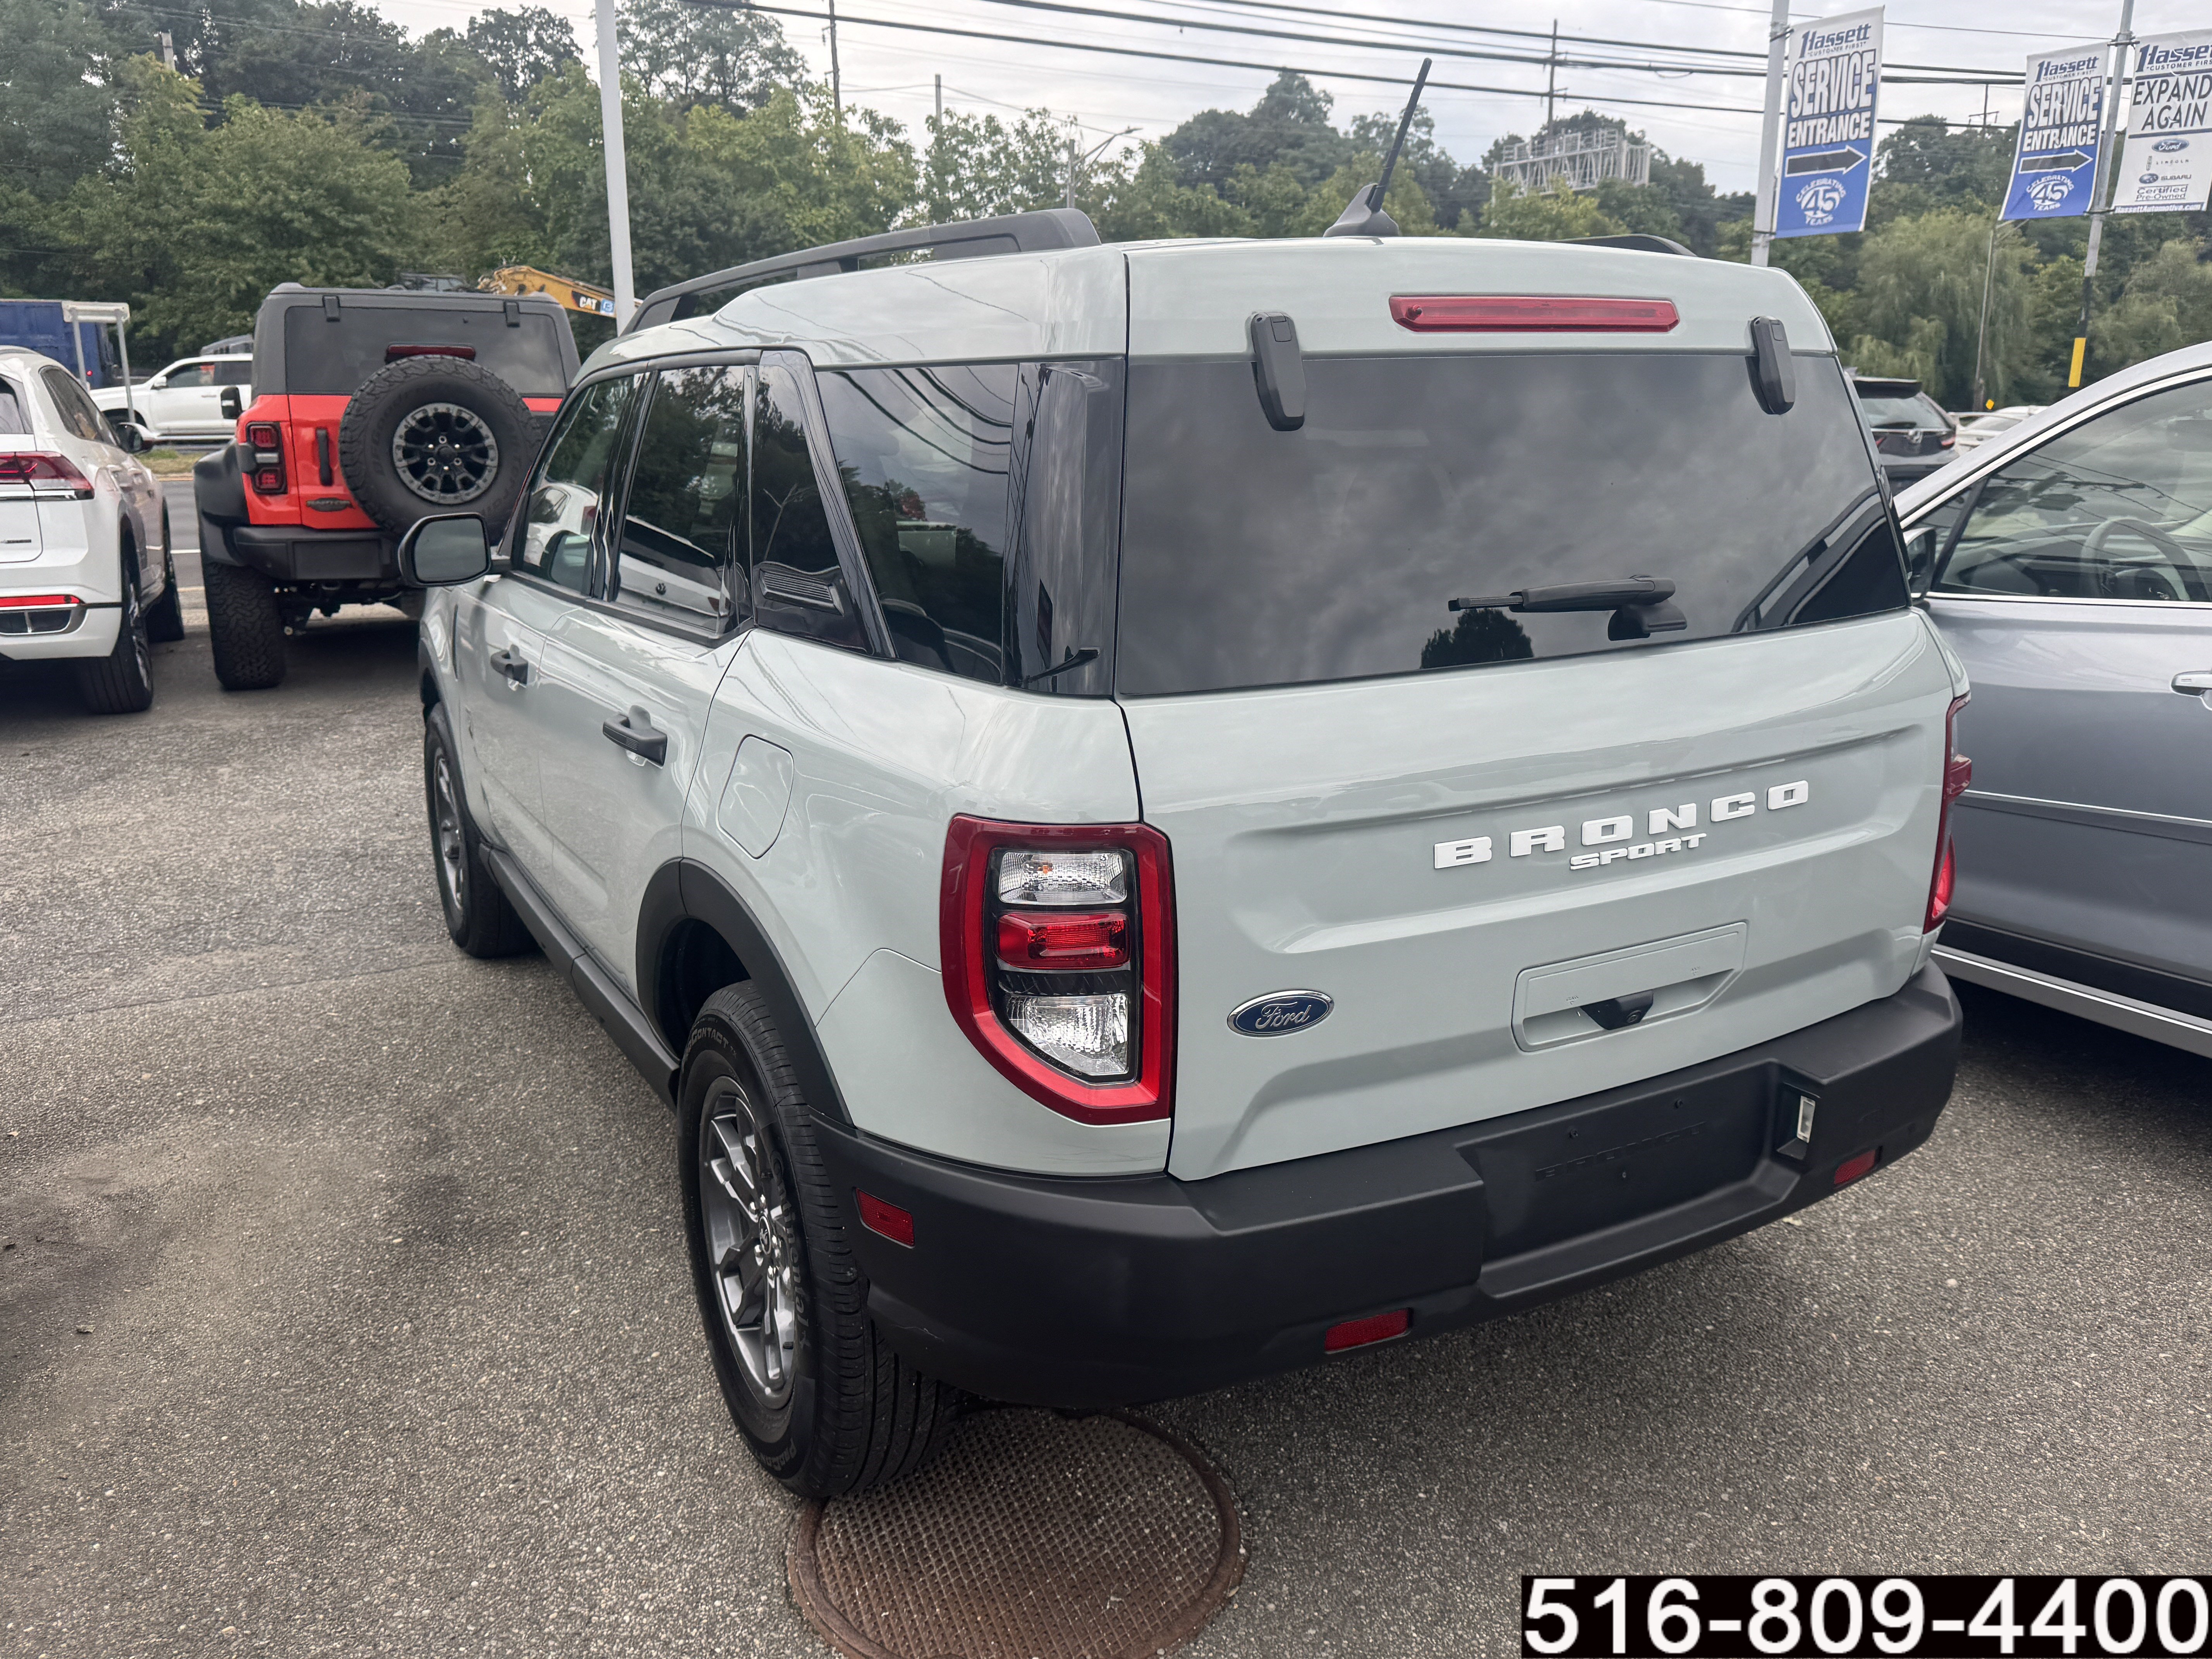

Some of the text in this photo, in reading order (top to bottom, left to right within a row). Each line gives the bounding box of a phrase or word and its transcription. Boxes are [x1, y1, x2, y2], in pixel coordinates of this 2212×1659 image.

[1799, 23, 1871, 58] Hassett
[2036, 56, 2099, 82] Hassett
[1791, 49, 1876, 119] SERVICE
[2028, 76, 2102, 129] SERVICE
[2142, 101, 2208, 131] AGAIN
[1787, 110, 1871, 149] ENTRANCE
[2022, 123, 2097, 152] ENTRANCE
[2158, 139, 2182, 150] Ford
[1796, 178, 1846, 202] CELEBRATING
[2026, 175, 2074, 193] CELEBRATING
[2032, 182, 2066, 204] 45
[2137, 185, 2188, 194] Certified
[1802, 187, 1838, 215] 45
[2034, 202, 2061, 211] YEARS
[1805, 214, 1833, 226] YEARS
[579, 296, 598, 310] CAT
[1433, 780, 1809, 869] BRONCO
[1570, 833, 1707, 871] SPORT
[1255, 1001, 1312, 1029] Ford
